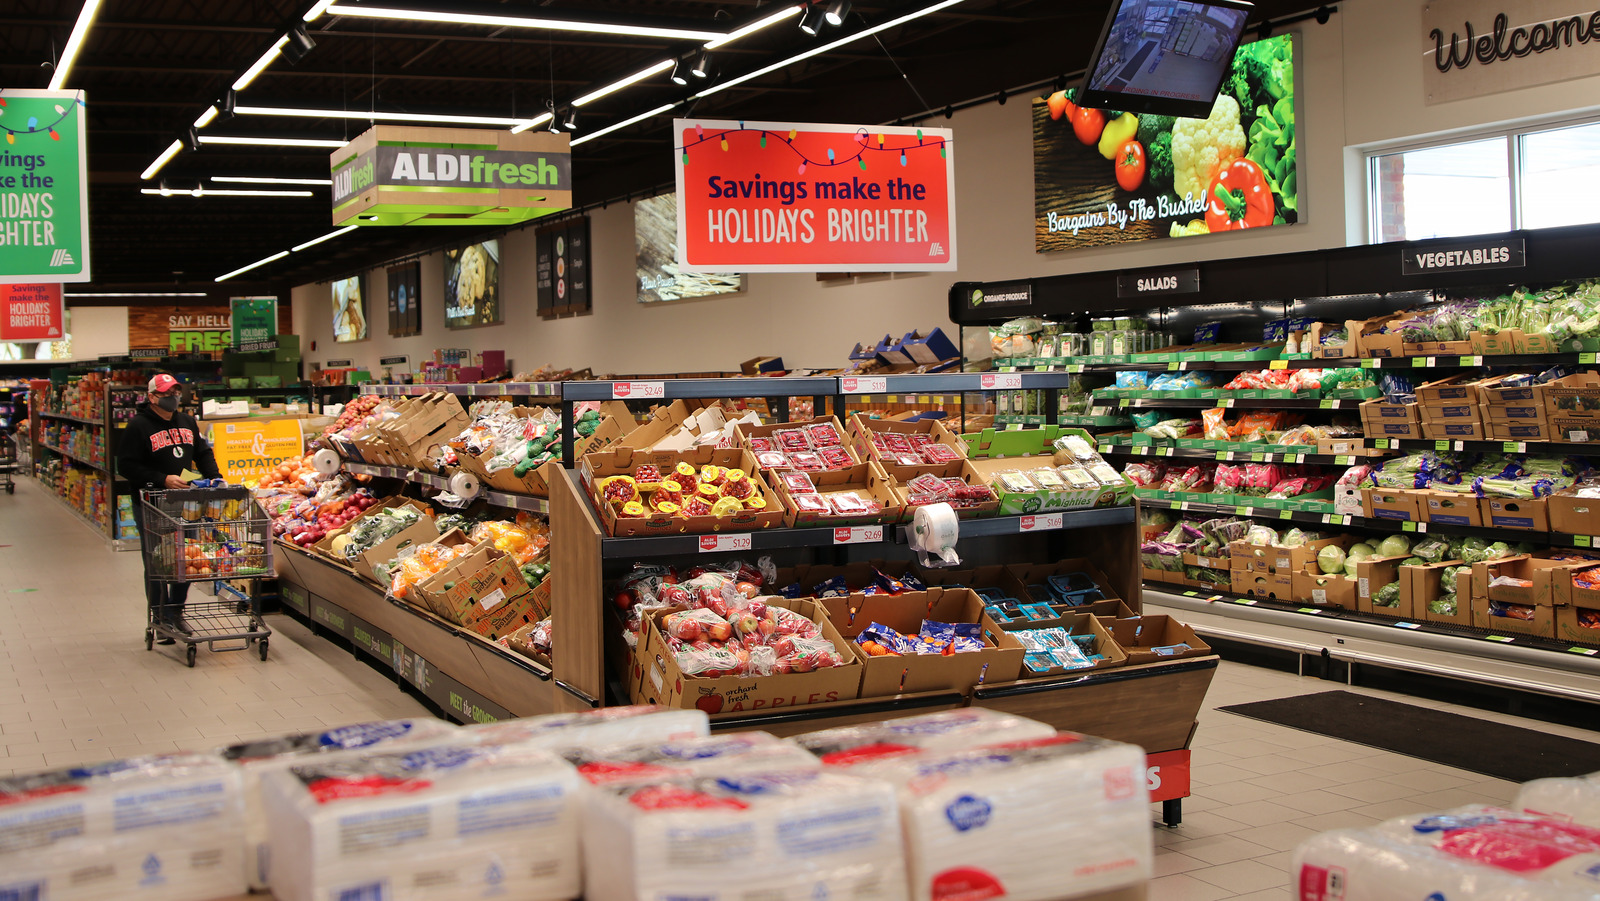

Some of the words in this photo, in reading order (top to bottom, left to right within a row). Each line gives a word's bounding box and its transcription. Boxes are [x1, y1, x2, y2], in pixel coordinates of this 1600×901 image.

[1429, 13, 1600, 73] Welcome
[1160, 90, 1200, 100] PROGRESS
[391, 152, 558, 185] ALDIfresh
[21, 172, 54, 188] the
[334, 156, 374, 202] ALDIfresh
[708, 173, 807, 205] Savings
[815, 176, 881, 200] make
[888, 177, 926, 201] the
[1047, 211, 1106, 236] Bargains
[1107, 203, 1128, 230] By
[1129, 198, 1156, 222] The
[1156, 189, 1210, 218] Bushel
[708, 208, 815, 243] HOLIDAYS
[828, 208, 929, 243] BRIGHTER
[1416, 246, 1510, 269] VEGETABLES
[12, 284, 46, 293] Savings
[1137, 275, 1177, 292] SALADS
[35, 293, 49, 301] the
[984, 294, 1005, 303] ORGANIC
[1005, 292, 1028, 301] PRODUCE
[10, 302, 50, 315] HOLIDAYS
[10, 314, 51, 327] BRIGHTER
[169, 315, 192, 327] SAY
[240, 328, 268, 337] HOLIDAYS
[240, 343, 258, 352] DRIED
[259, 341, 277, 350] FRUIT
[131, 349, 166, 357] VEGETABLES
[872, 381, 886, 390] $1.19
[1006, 378, 1021, 387] $3.29
[645, 386, 663, 396] $2.49
[228, 457, 290, 469] POTATO
[228, 468, 256, 476] HAVE
[1044, 497, 1091, 508] Mighties
[1047, 517, 1062, 527] $1.69
[864, 530, 881, 540] $2.69
[733, 538, 750, 548] $1.29
[725, 683, 758, 696] orchard
[449, 690, 463, 712] MEET
[463, 699, 472, 718] the
[728, 693, 749, 704] fresh
